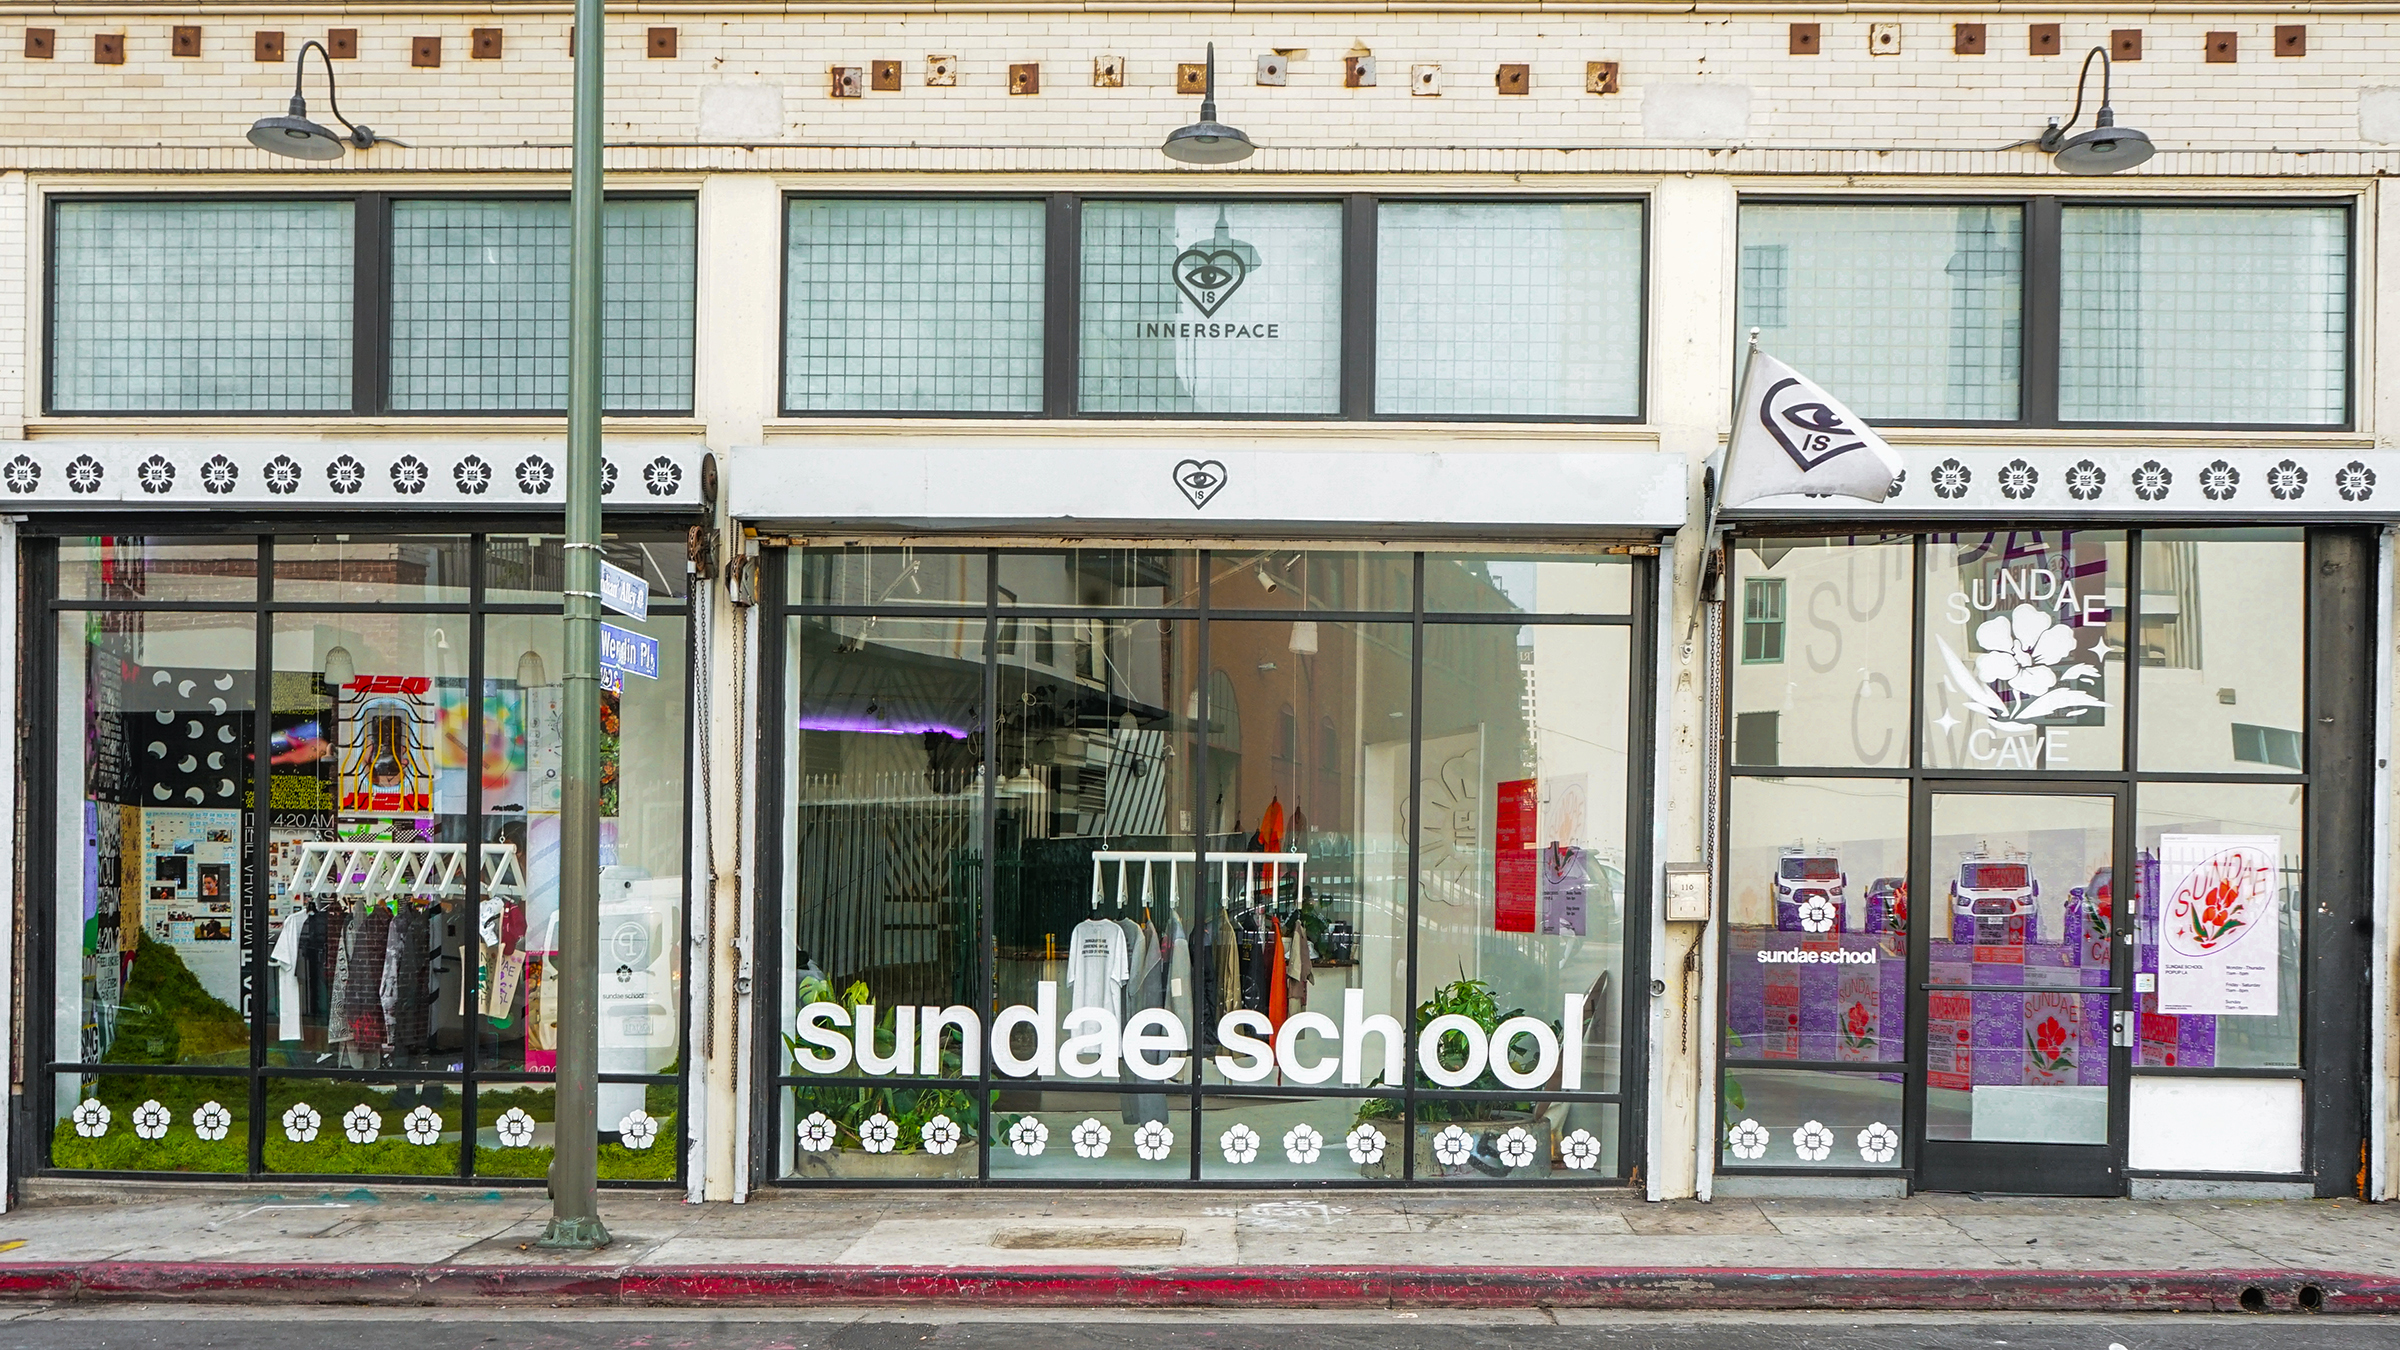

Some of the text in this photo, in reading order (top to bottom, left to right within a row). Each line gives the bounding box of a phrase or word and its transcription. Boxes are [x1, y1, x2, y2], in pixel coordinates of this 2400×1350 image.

[1201, 291, 1216, 304] IS
[1136, 322, 1280, 338] INNERSPACE
[1801, 433, 1831, 452] IS
[1194, 490, 1205, 500] IS
[619, 581, 637, 611] Alley
[1945, 567, 2107, 627] SUNDAE
[601, 629, 637, 665] Werdin
[1969, 728, 2070, 768] CAVE
[274, 813, 307, 828] 4:20
[308, 813, 335, 828] AM
[2174, 852, 2270, 919] SUNDAE
[1757, 947, 1877, 964] sundae school
[1839, 979, 1879, 1007] SUNDAE
[2024, 992, 2079, 1023] SUNDAE
[794, 980, 1583, 1091] sundae school
